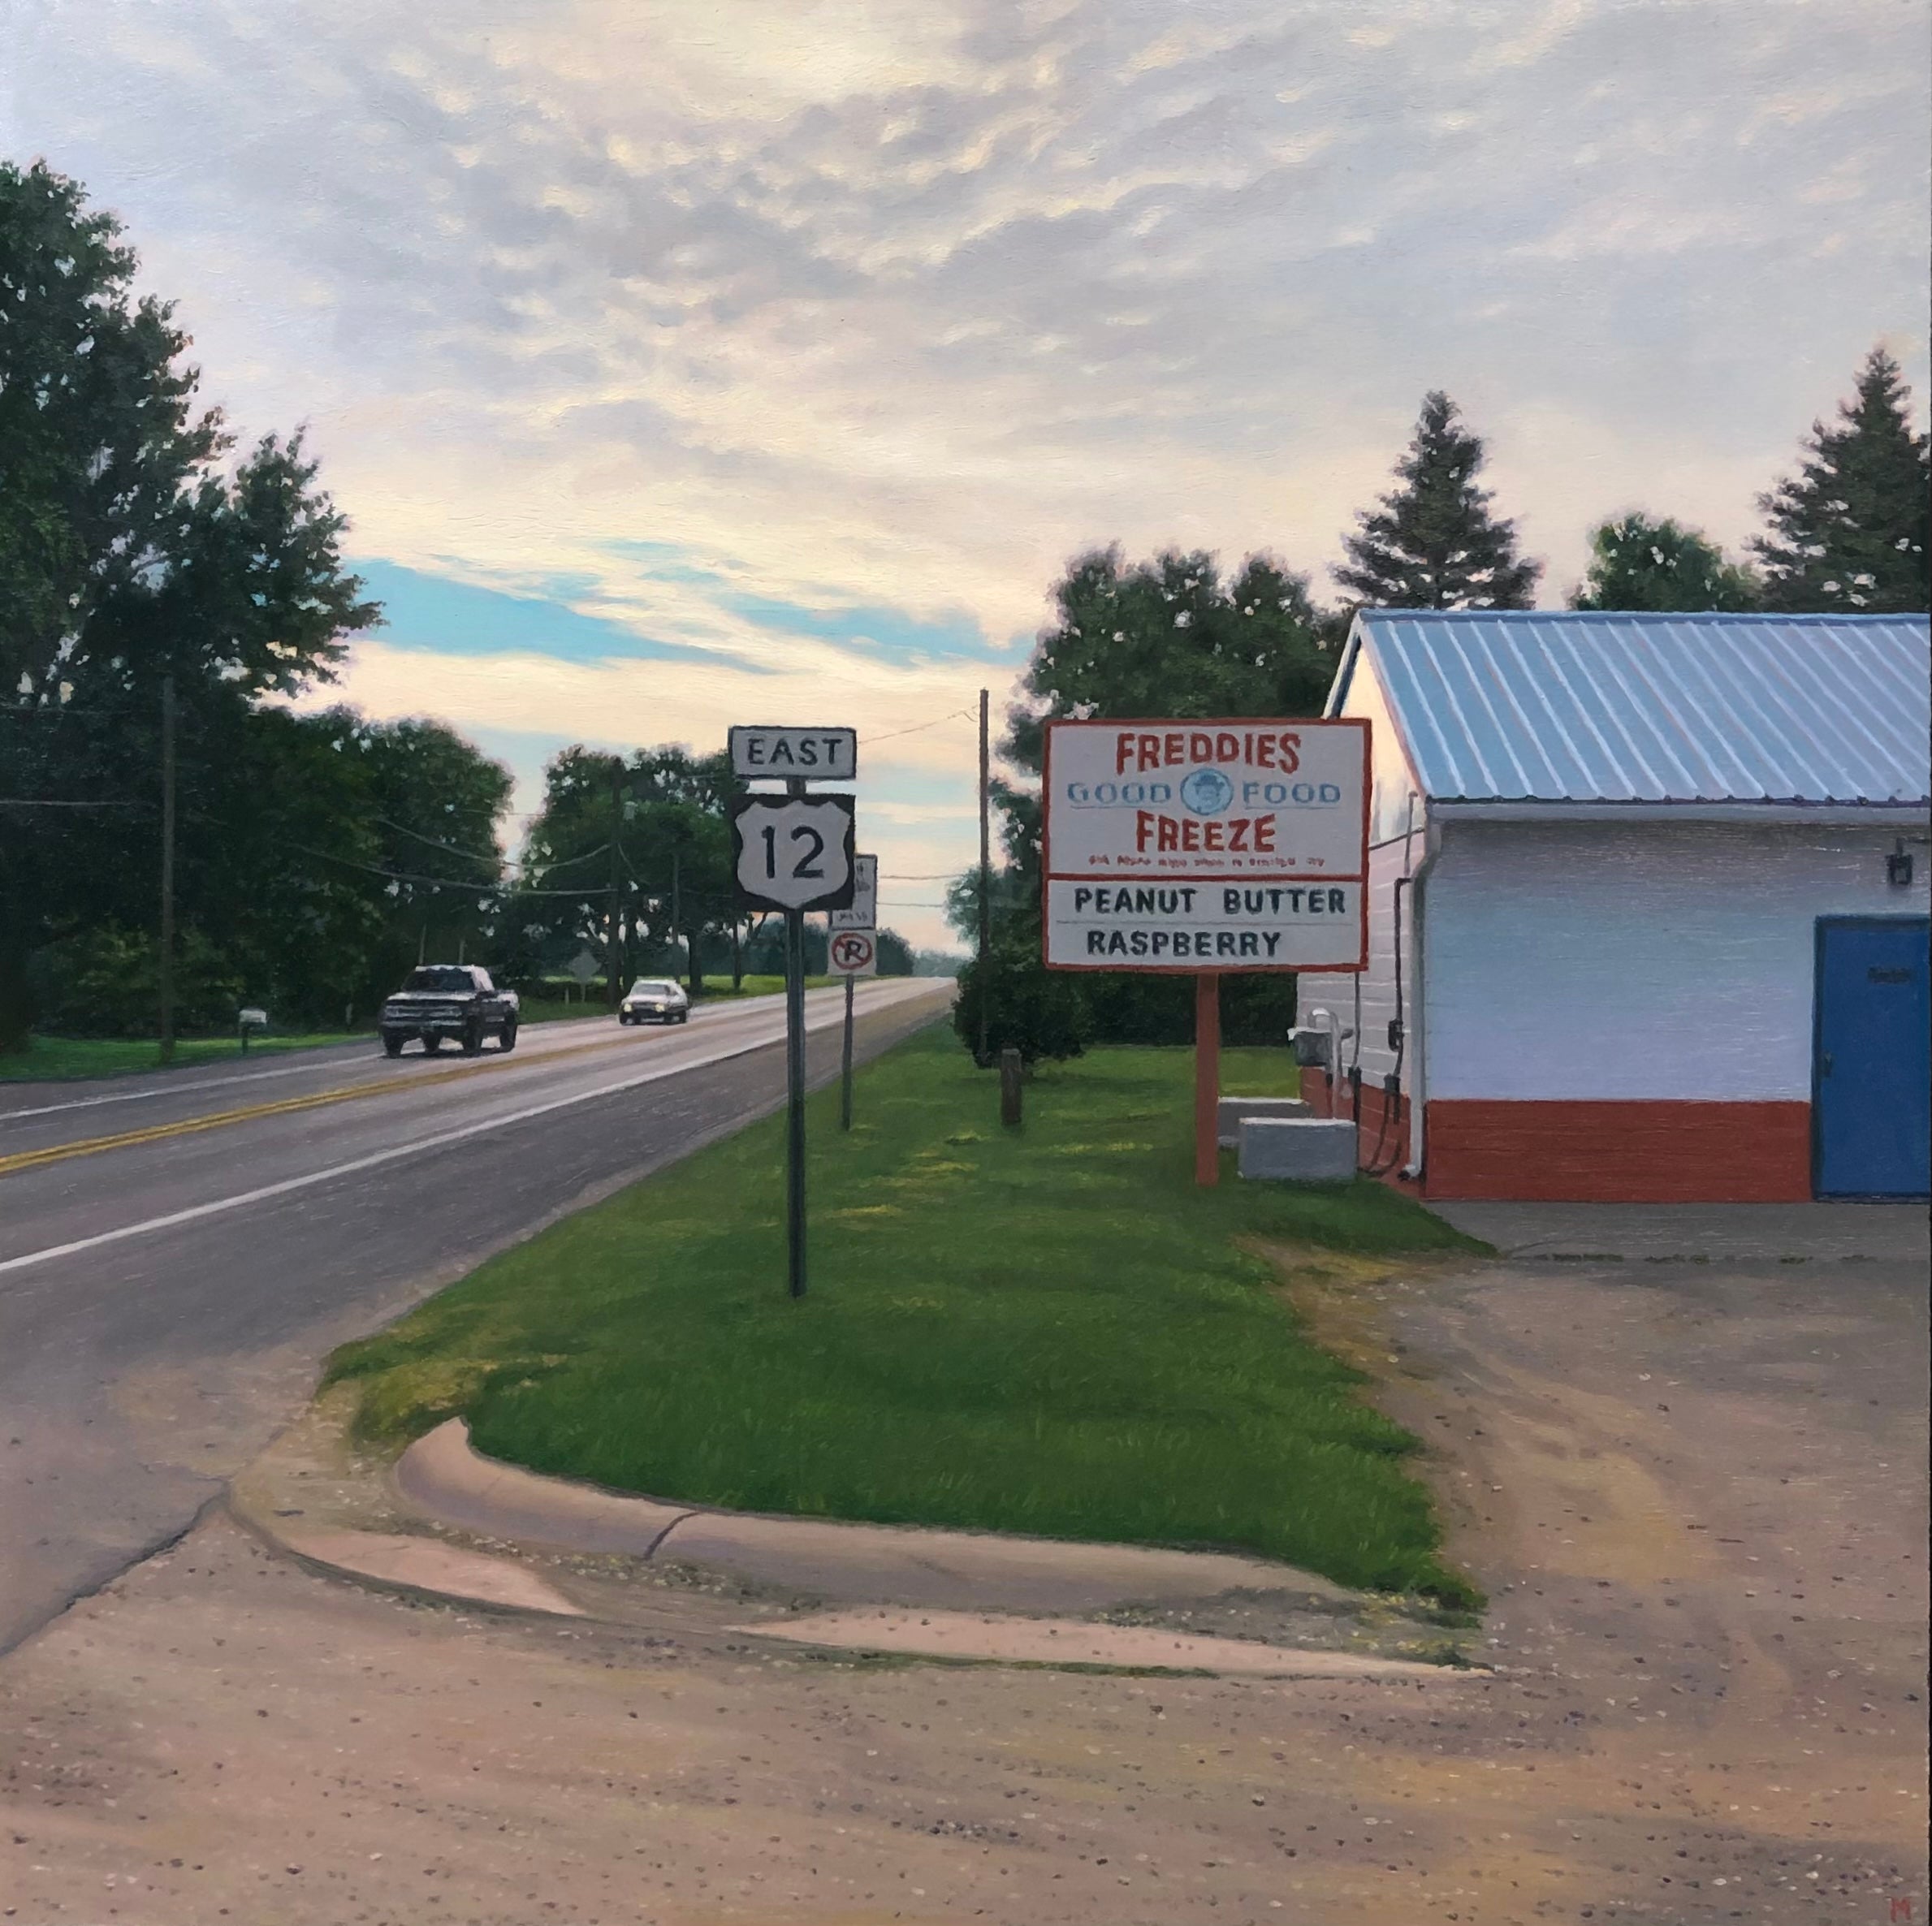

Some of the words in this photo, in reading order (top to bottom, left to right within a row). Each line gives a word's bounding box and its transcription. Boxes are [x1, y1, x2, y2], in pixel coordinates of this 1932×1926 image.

[747, 738, 843, 765] EAST
[1116, 732, 1301, 775] FREDDIES
[1067, 782, 1171, 804] GOOD
[1243, 782, 1341, 804] FOOD
[1136, 810, 1275, 853] FREEZE
[761, 825, 824, 879] 12
[1074, 887, 1197, 913] PEANUT
[1223, 887, 1345, 914] BUTTER
[1087, 931, 1281, 957] RASPBERRY
